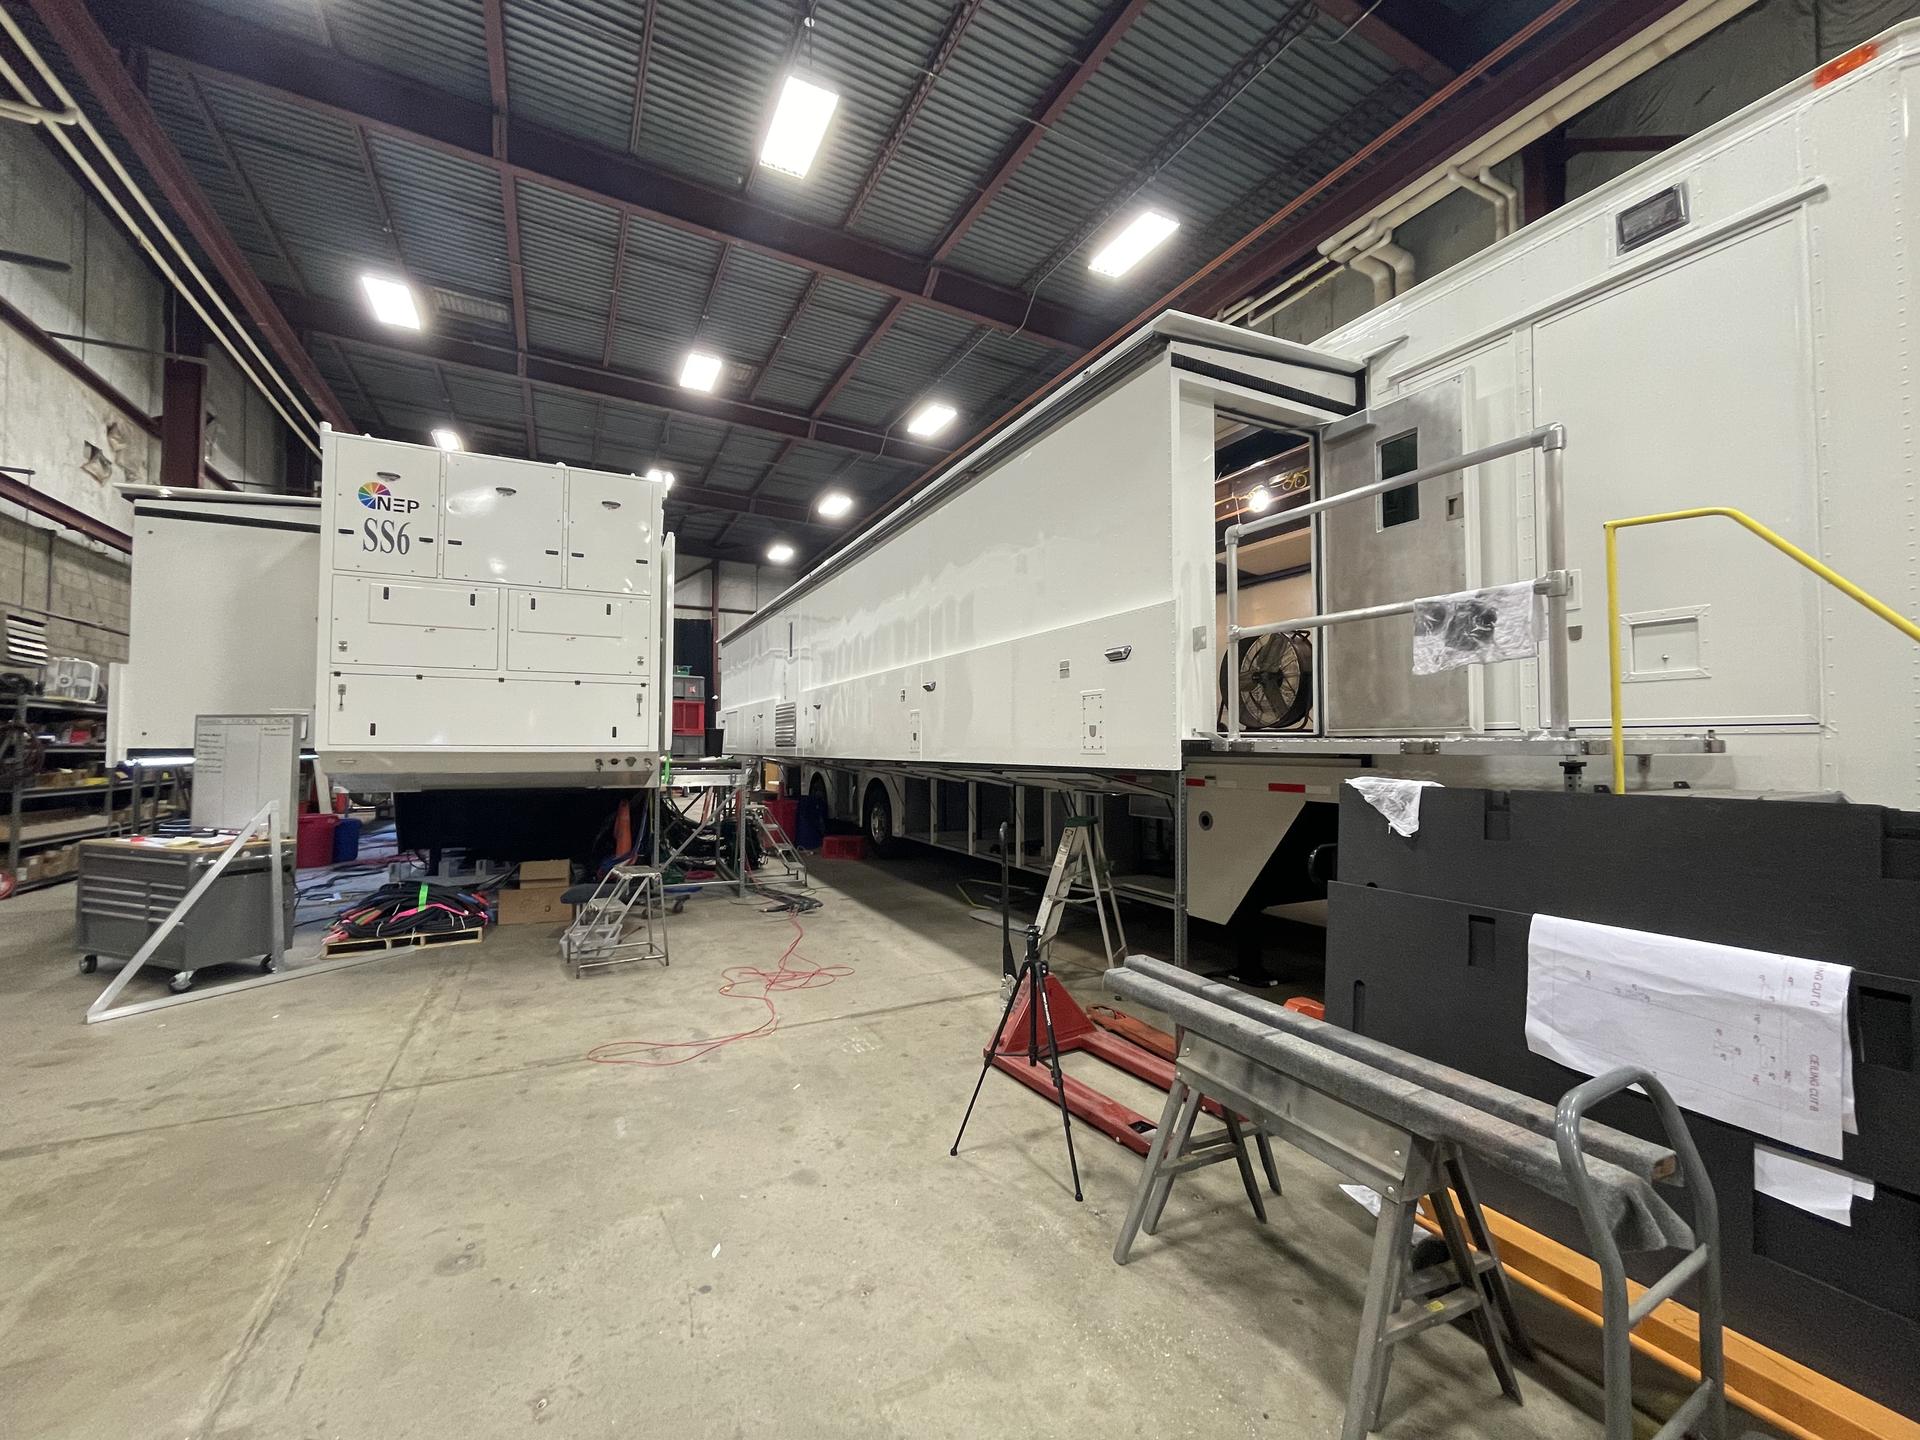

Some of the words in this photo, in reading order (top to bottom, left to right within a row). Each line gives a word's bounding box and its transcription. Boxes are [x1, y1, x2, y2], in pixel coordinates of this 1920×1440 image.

[376, 495, 420, 514] NEP
[362, 517, 411, 555] SS6
[1811, 982, 1823, 999] CUT
[1808, 1054, 1820, 1087] CEILING
[1808, 1088, 1820, 1105] CUT
